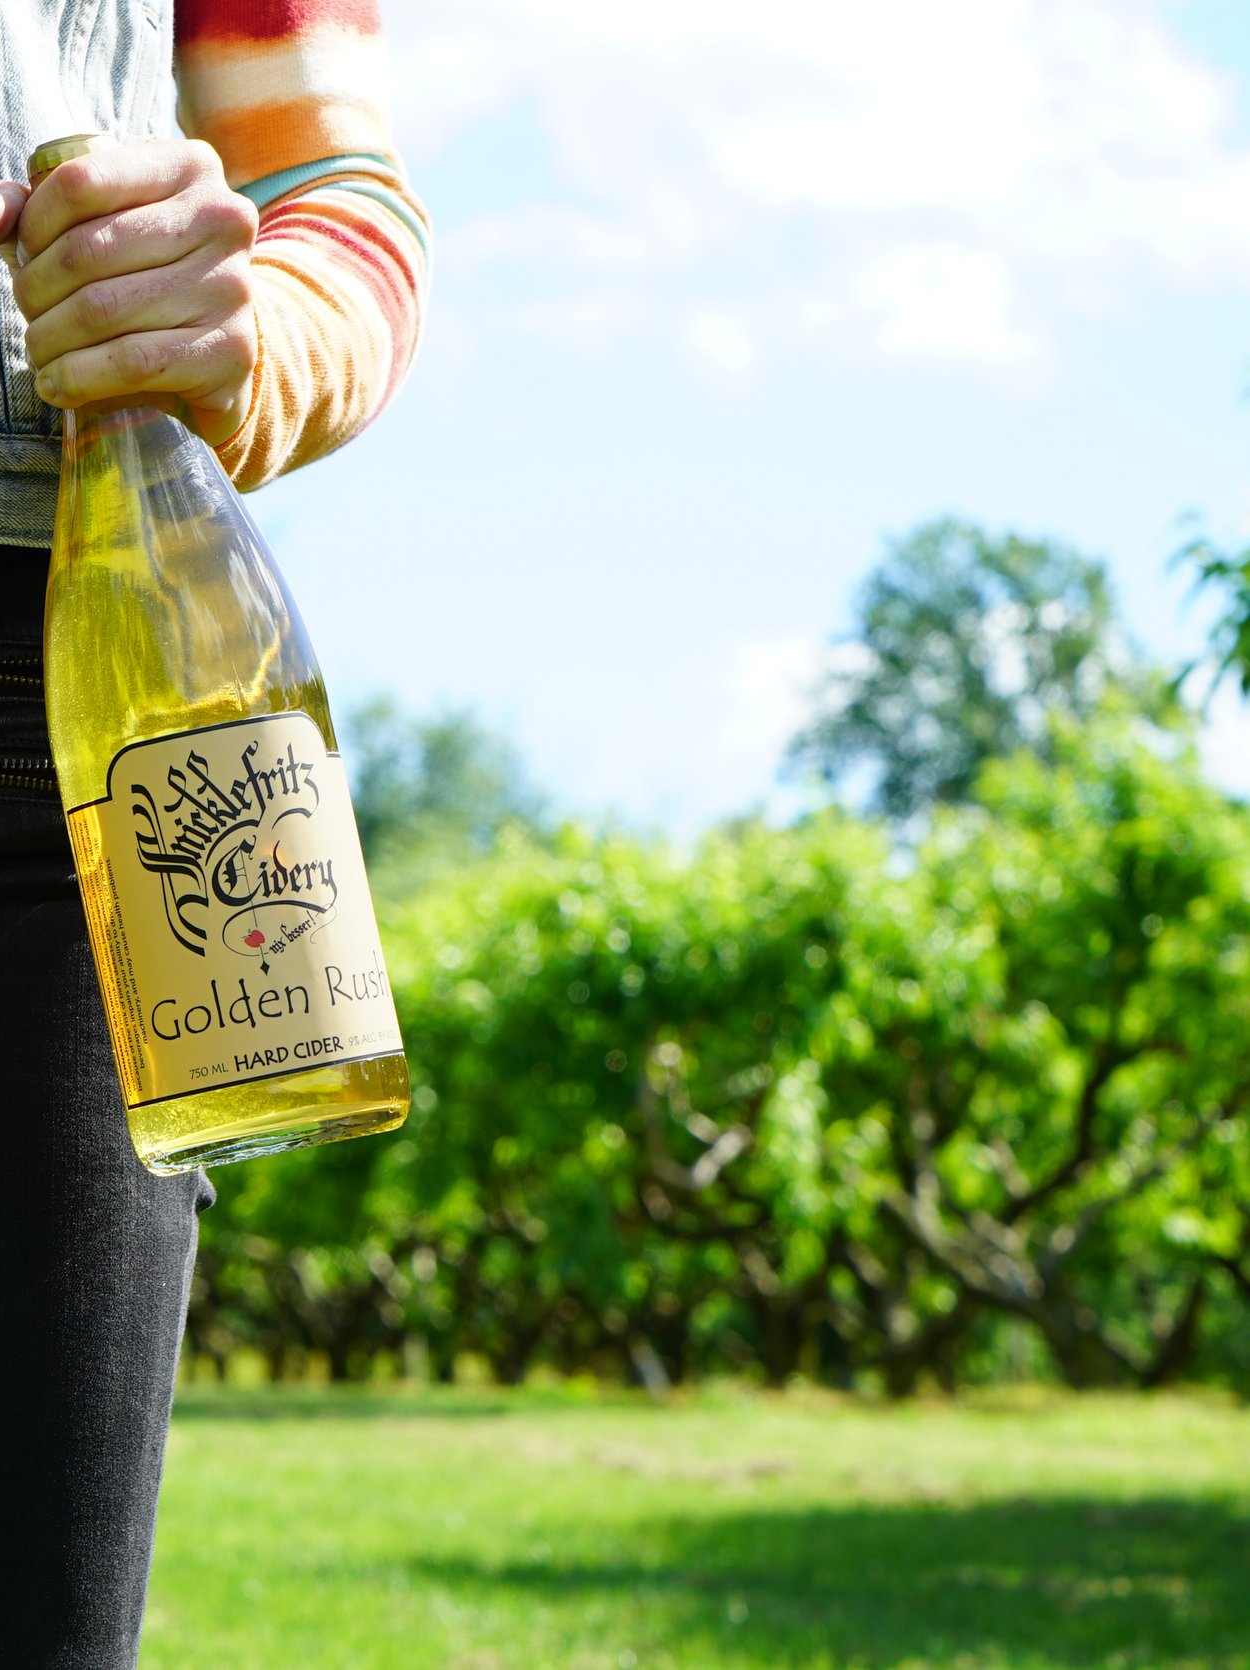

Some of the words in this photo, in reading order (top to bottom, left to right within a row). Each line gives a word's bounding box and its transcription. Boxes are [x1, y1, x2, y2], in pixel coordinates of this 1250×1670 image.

[104, 855, 119, 901] problems.
[211, 834, 338, 915] Cidery
[280, 910, 317, 943] besser!
[124, 990, 136, 1023] impairs
[151, 979, 310, 1041] Golden
[325, 949, 389, 1006] Rush
[133, 996, 149, 1045] machinery,
[131, 1024, 146, 1069] beverages
[189, 1066, 209, 1080] 750
[212, 1063, 229, 1075] ML
[234, 1047, 289, 1072] HARD
[294, 1036, 344, 1059] CIDER
